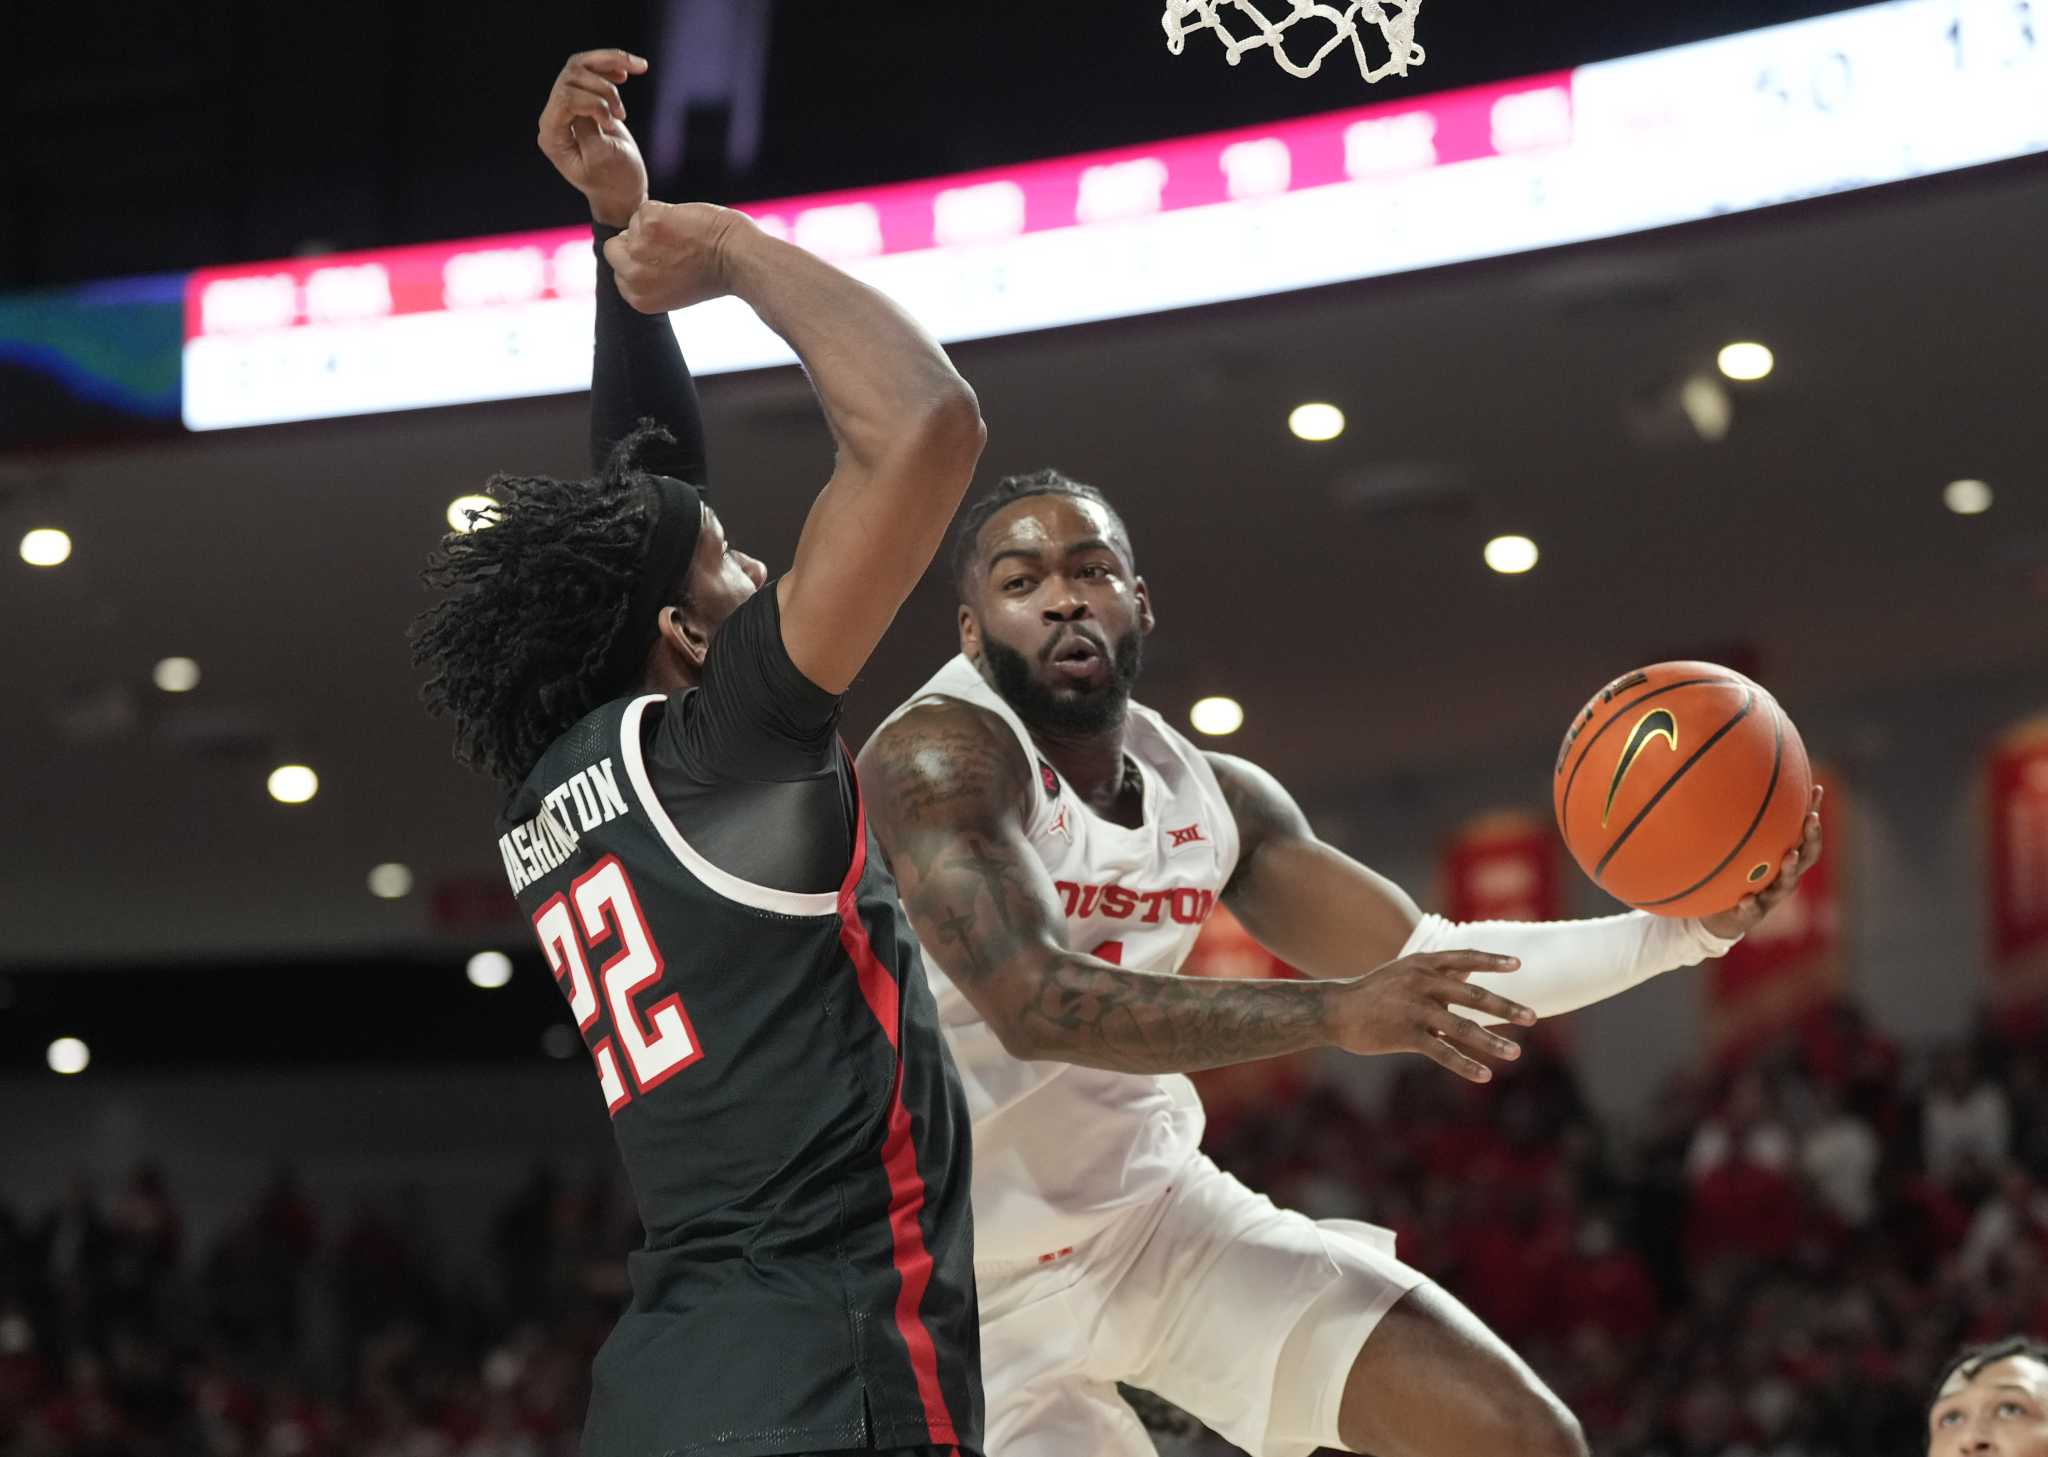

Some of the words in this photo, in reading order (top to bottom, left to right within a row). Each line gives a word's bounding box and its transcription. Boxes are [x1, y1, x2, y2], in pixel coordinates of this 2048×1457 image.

[498, 757, 629, 899] ASHINTON
[1055, 880, 1215, 925] OUSTON
[532, 853, 704, 1119] 22
